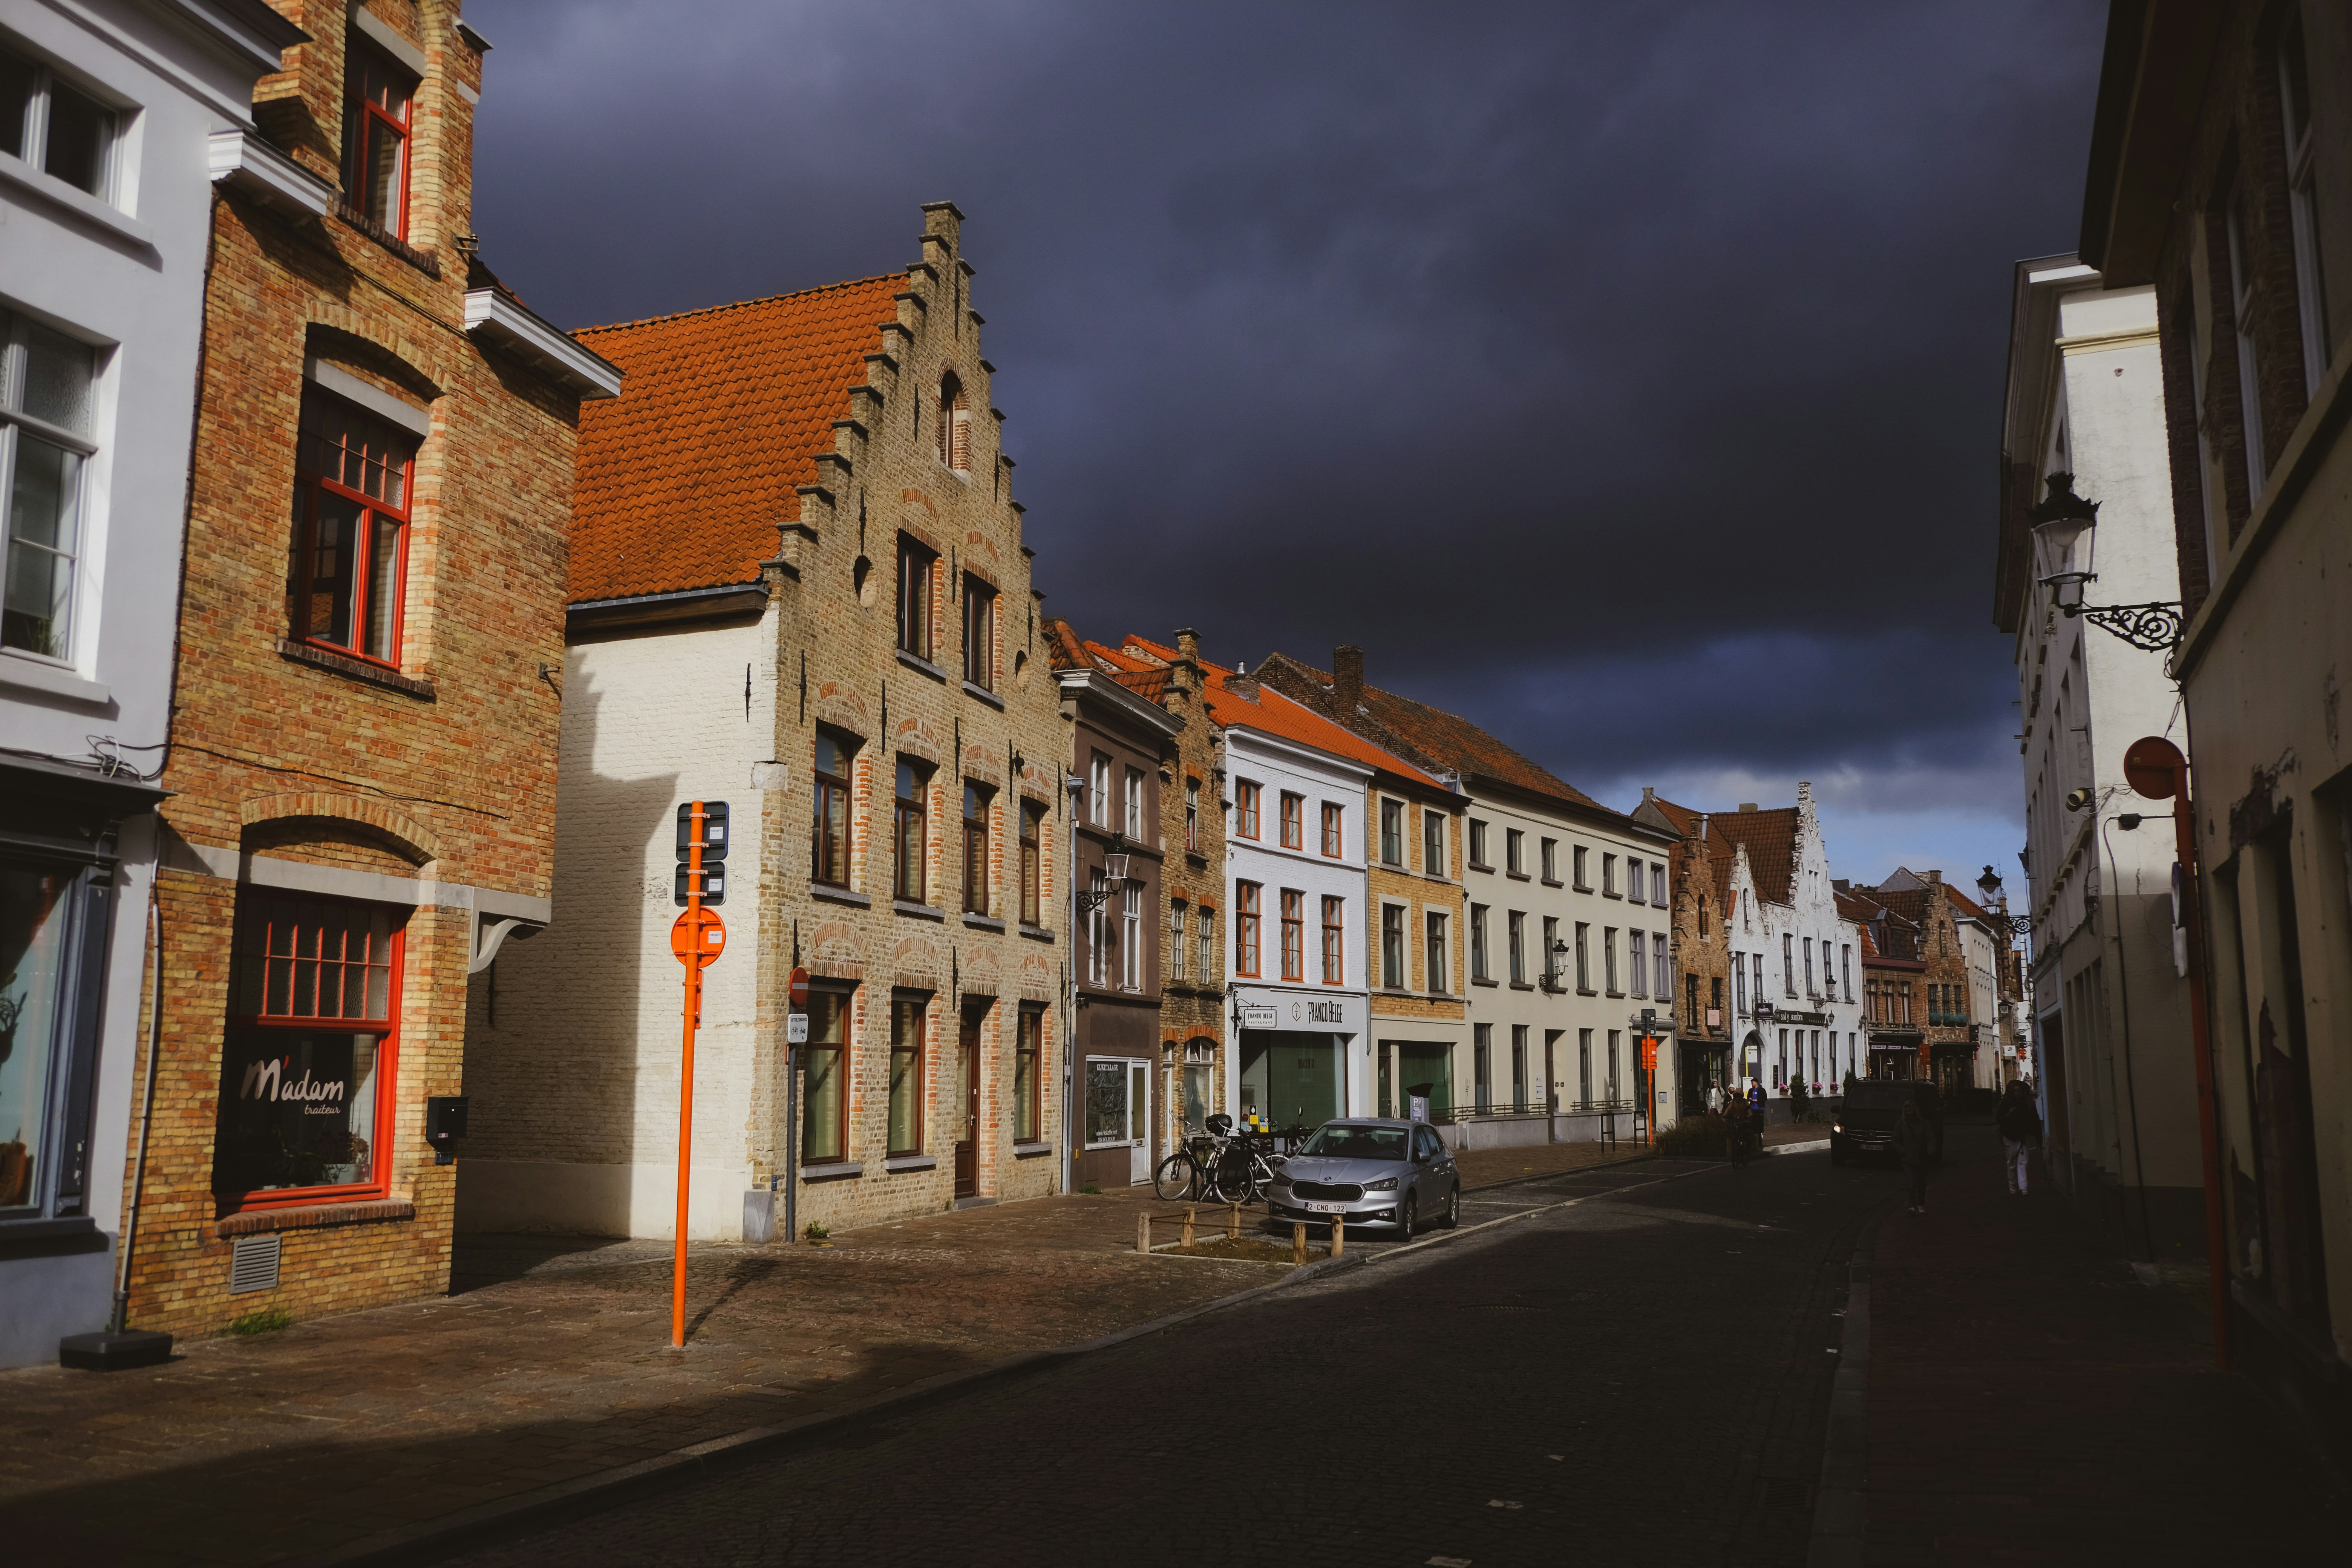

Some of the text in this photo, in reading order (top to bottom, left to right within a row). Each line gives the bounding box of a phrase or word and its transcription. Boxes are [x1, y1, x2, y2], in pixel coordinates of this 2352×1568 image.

[1308, 1000, 1342, 1024] FRANCO BELGE
[1787, 1014, 1789, 1023] y
[1790, 1012, 1803, 1021] sombra
[304, 1104, 341, 1115] traiteur
